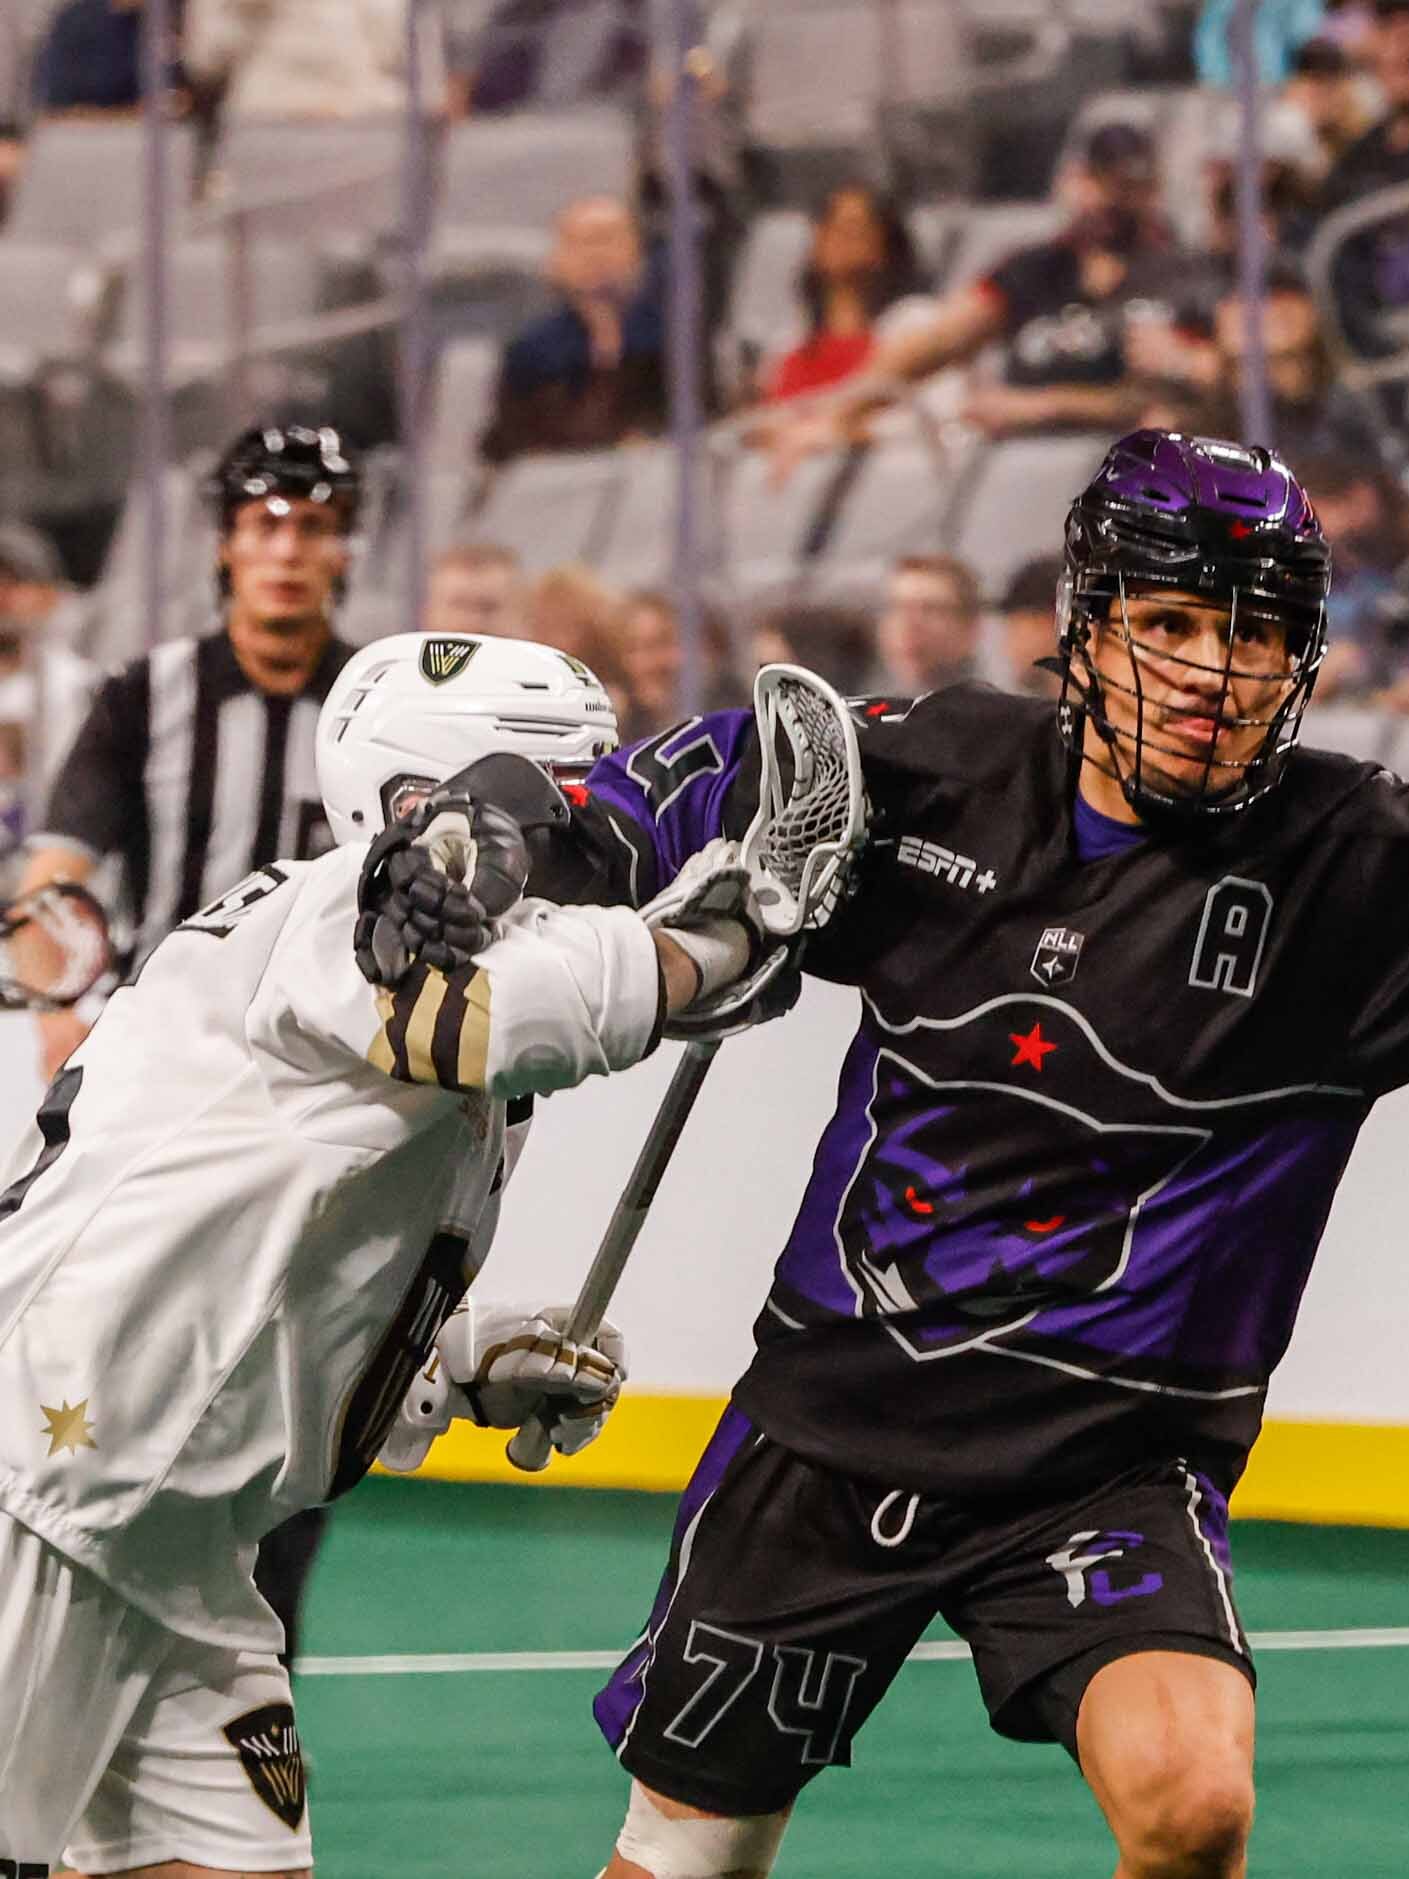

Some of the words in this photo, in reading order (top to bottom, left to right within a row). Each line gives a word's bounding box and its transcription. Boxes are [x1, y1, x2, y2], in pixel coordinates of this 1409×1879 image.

[897, 835, 997, 894] ESPN+
[1042, 930, 1079, 952] NLL
[1188, 874, 1274, 998] A
[663, 1619, 868, 1765] 74
